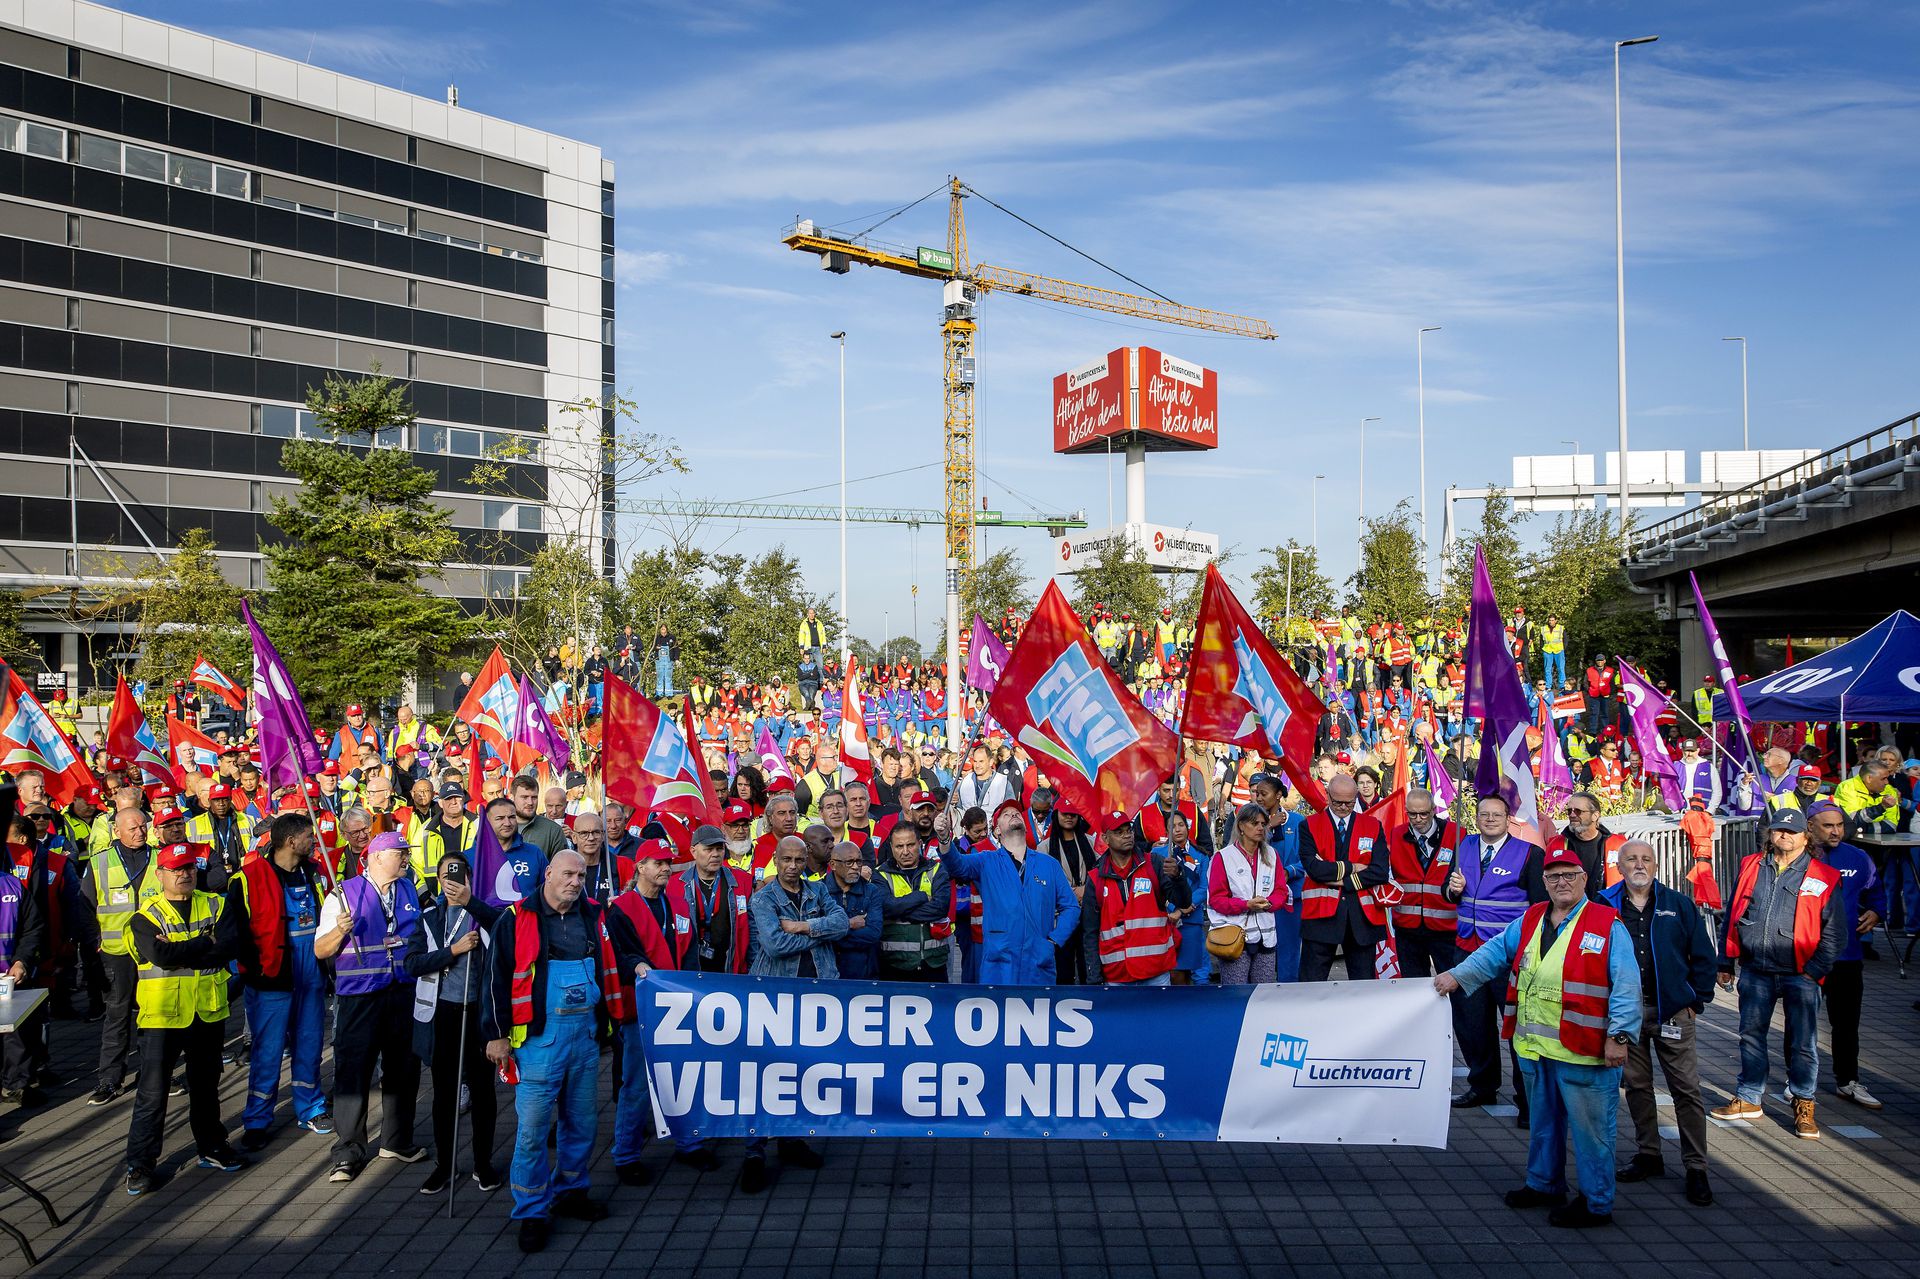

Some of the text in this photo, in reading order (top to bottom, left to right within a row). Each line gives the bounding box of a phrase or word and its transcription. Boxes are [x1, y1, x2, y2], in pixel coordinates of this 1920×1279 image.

[932, 253, 951, 265] bam
[1056, 382, 1100, 428] Altijd de
[1148, 374, 1194, 414] Altijd de
[1068, 392, 1122, 447] beste deal
[1161, 406, 1215, 434] beste deal
[1166, 538, 1213, 554] VLIEGTICKETS.NL
[1037, 660, 1131, 759] FNV
[1134, 880, 1151, 890] FNV
[1581, 935, 1604, 949] FNV
[654, 992, 1094, 1048] ZONDER ONS
[1263, 1040, 1308, 1061] FNV
[1309, 1064, 1413, 1080] Luchtvaart
[653, 1061, 1166, 1119] VLIEGT ER NIKS
